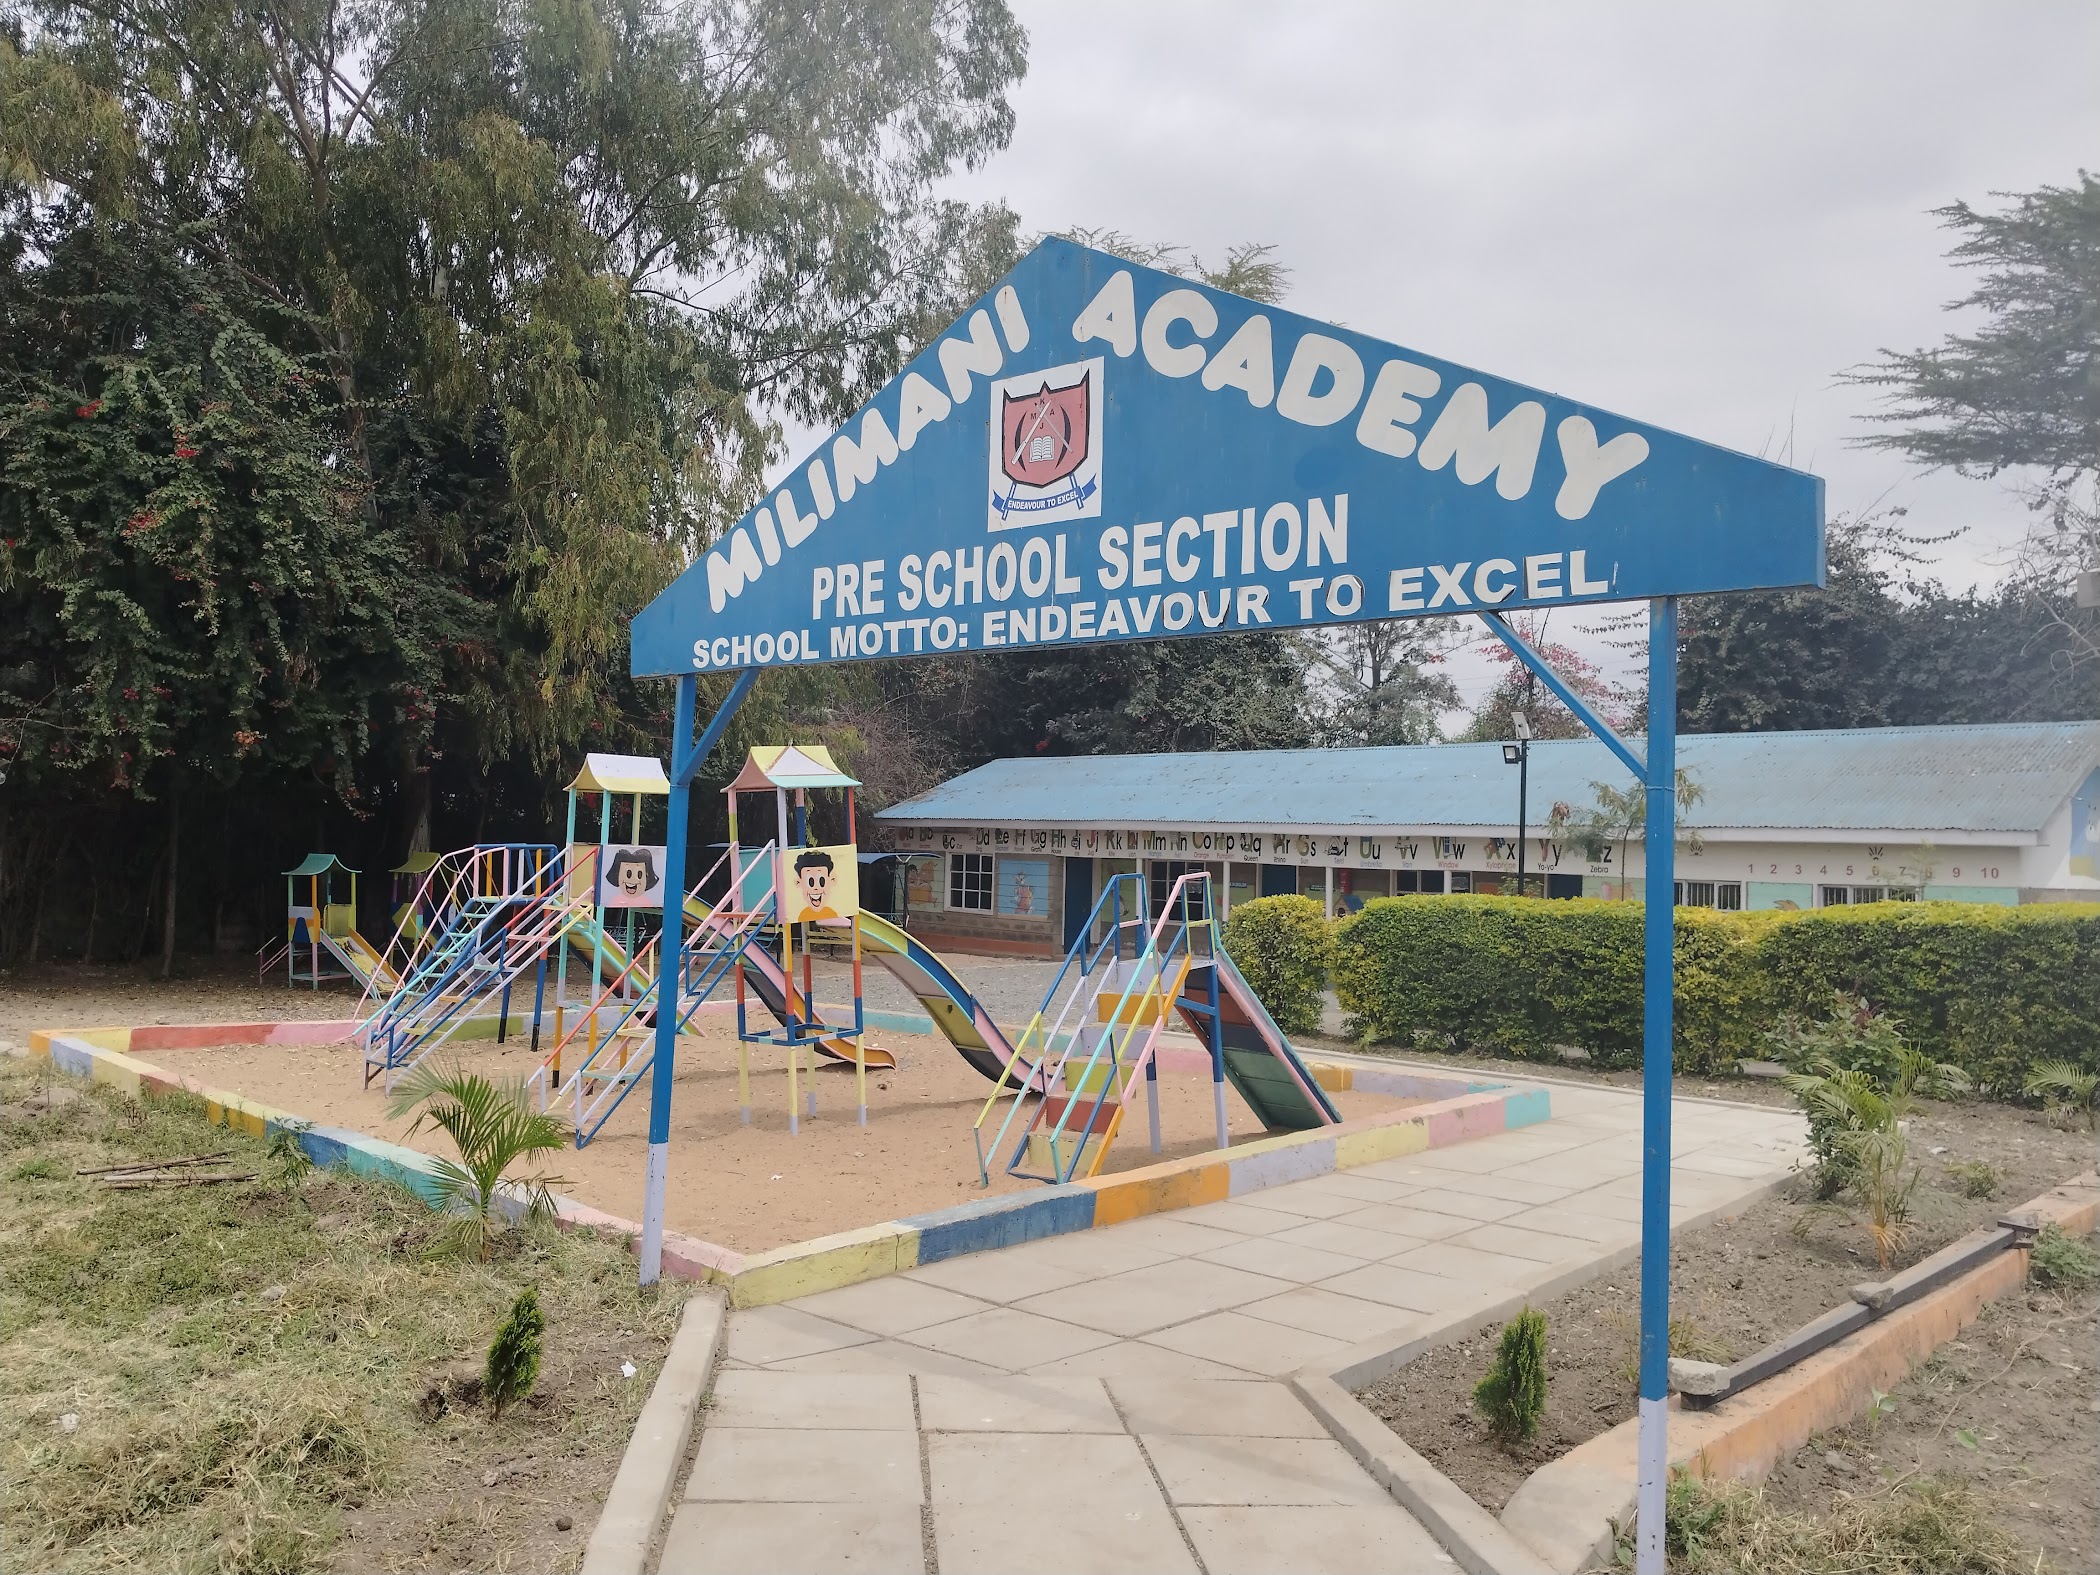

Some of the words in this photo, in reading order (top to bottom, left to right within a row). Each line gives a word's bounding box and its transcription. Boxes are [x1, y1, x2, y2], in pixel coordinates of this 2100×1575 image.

[706, 285, 1030, 614] MILIMANI
[1072, 270, 1650, 521] ACADEMY
[1007, 500, 1046, 510] ENDEAVOUR
[1046, 498, 1056, 507] TO
[1057, 490, 1079, 505] EXCEL
[812, 559, 885, 620] PRE
[897, 533, 1081, 612] SCHOOL
[1097, 493, 1348, 590] SECTION
[692, 630, 820, 669] SCHOOL
[830, 616, 968, 658] MOTTO:
[983, 585, 1272, 646] ENDEAVOUR
[1289, 574, 1365, 620] TO
[1389, 550, 1609, 612] EXCEL
[1030, 829, 1047, 849] Gg
[1360, 836, 1381, 860] Uu
[1538, 838, 1562, 866] Yy
[1193, 852, 1210, 860] Orange
[1216, 852, 1235, 860] Pumpkin
[1243, 854, 1259, 862] Queen
[1537, 862, 1555, 871] Yo-yo
[1590, 865, 1609, 873] Zebra
[1770, 864, 1777, 875] 2
[1795, 864, 1802, 875] 3
[1819, 865, 1828, 875] 4
[1846, 865, 1854, 876] 5
[1872, 866, 1879, 876] 6
[1898, 866, 1906, 877] 7
[1952, 867, 1961, 878] 9
[1981, 868, 1999, 879] 10
